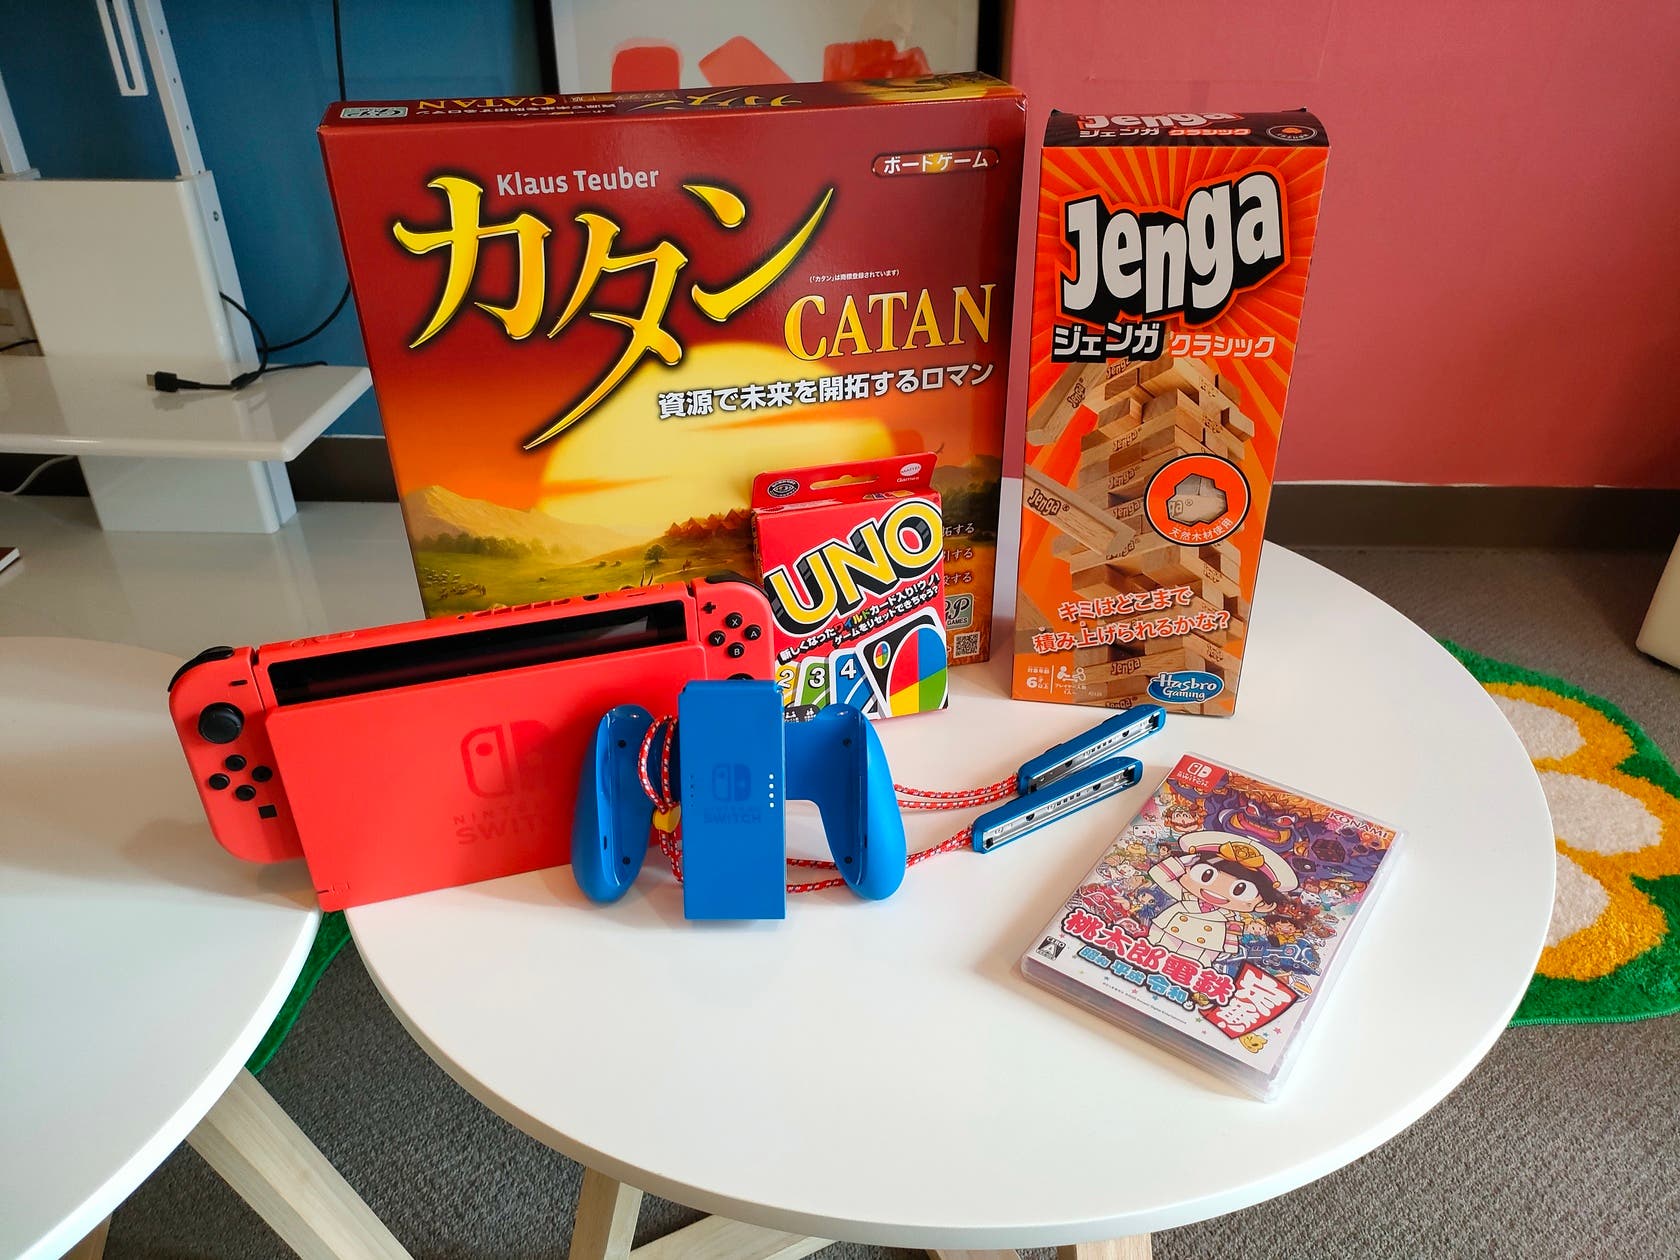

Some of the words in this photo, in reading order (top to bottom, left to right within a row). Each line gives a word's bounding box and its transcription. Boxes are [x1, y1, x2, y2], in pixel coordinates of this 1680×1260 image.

[1080, 128, 1160, 138] ジェンガ
[884, 151, 988, 175] ボードゲーム
[496, 171, 568, 196] Klaus
[573, 166, 659, 192] Teuber
[1062, 173, 1282, 314] Jenga
[392, 176, 834, 450] カタン
[783, 283, 996, 361] CATAN
[1053, 322, 1161, 356] ジェンガ
[1170, 335, 1276, 359] クラシック
[657, 363, 995, 419] 資源で未来を開拓するロマン
[1028, 488, 1062, 516] Jenga
[1168, 517, 1234, 543] 天然木材使用
[764, 499, 943, 632] UNO
[1058, 586, 1194, 622] キミはどこまで
[731, 618, 739, 627] X
[750, 630, 758, 638] A
[1033, 610, 1231, 655] 積み上げられるかな?
[714, 635, 721, 644] Y
[733, 648, 741, 656] B
[778, 669, 794, 689] 2
[808, 667, 826, 689] 3
[840, 658, 857, 680] 4
[1111, 657, 1142, 676] Jenga
[1152, 673, 1218, 692] Hasbro
[1162, 686, 1206, 702] Gaming
[1329, 812, 1388, 838] KONAMI
